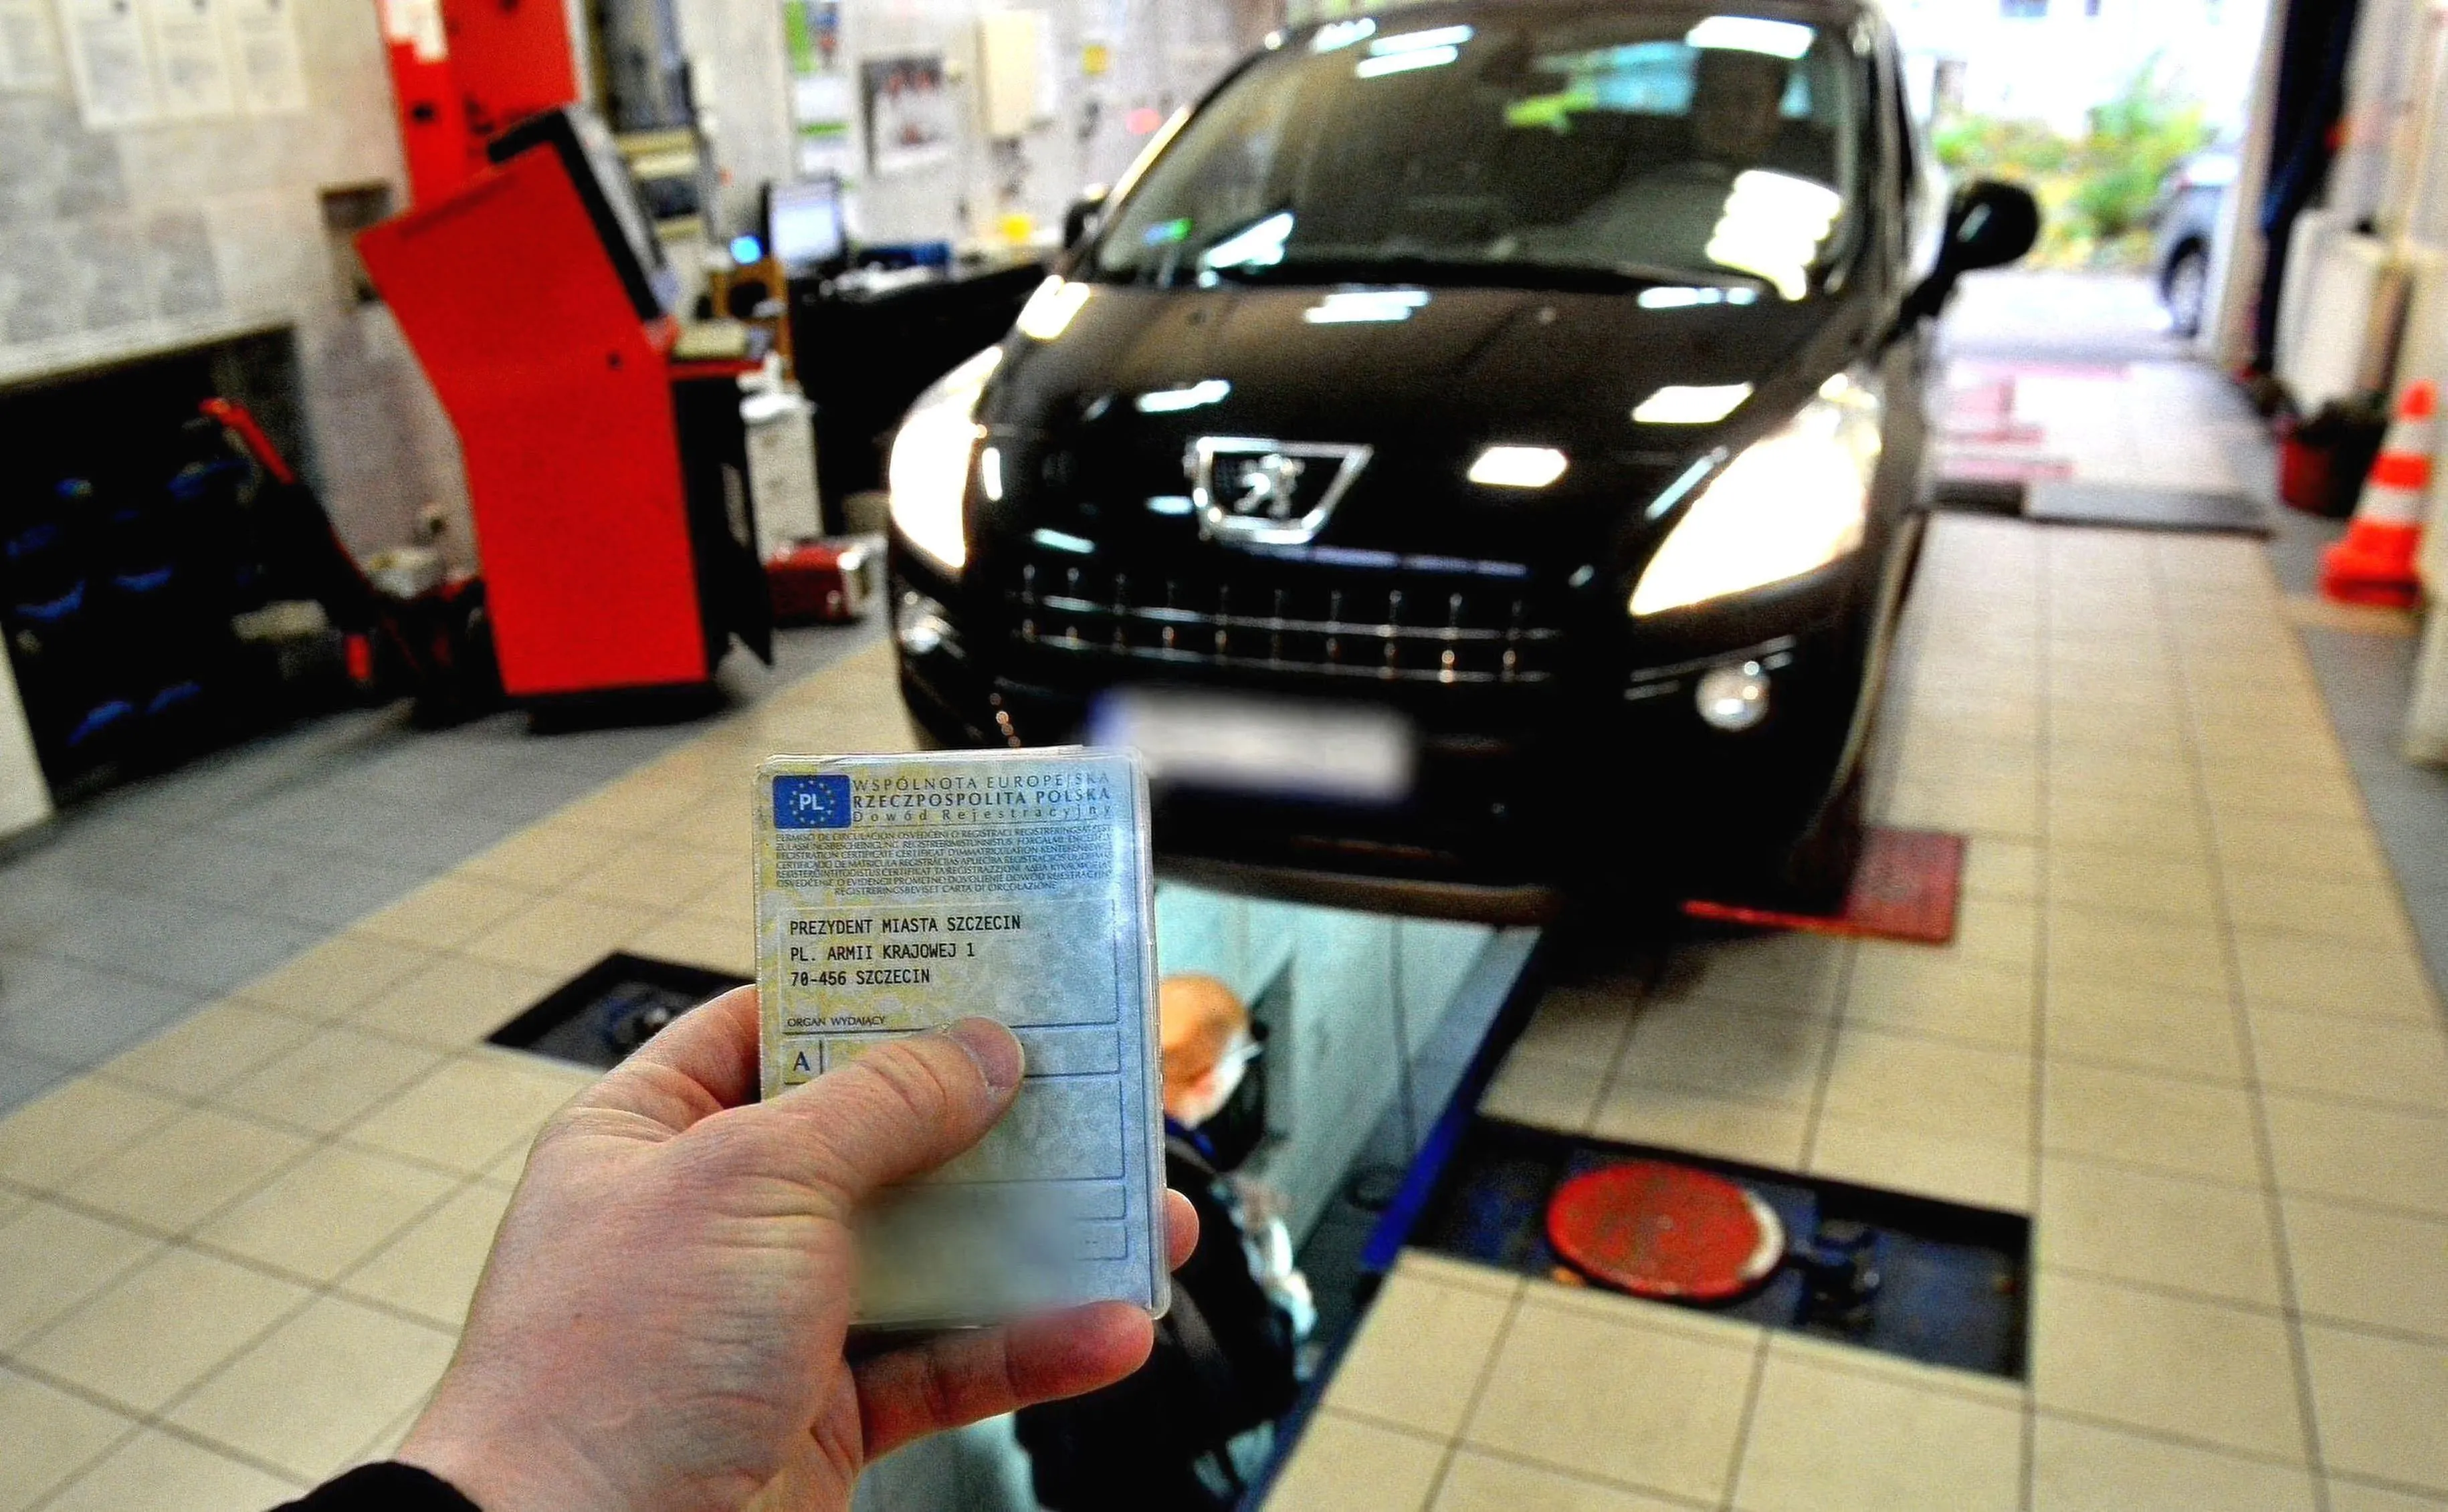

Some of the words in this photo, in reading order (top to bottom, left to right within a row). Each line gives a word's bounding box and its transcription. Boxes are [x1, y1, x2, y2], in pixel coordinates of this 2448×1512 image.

[853, 776, 977, 792] WSPÓLNOTA
[987, 773, 1109, 788] EUROPEJSKA
[800, 794, 824, 811] PL
[853, 792, 1026, 808] RZECZPOSPOLITA
[1037, 788, 1110, 803] POLSKA
[853, 810, 927, 822] Dowód
[942, 804, 1110, 822] Rejestracyjny
[791, 919, 873, 935] PREZYDENT
[882, 917, 938, 934] MIASTA
[948, 915, 1021, 932] SZCZECIN
[791, 947, 816, 961] PL.
[827, 946, 873, 960] ARMII
[883, 943, 956, 959] KRAJOWEJ
[967, 943, 975, 957] 1
[791, 971, 847, 986] 70-456
[856, 970, 930, 984] SZCZECIN
[787, 1018, 825, 1027] ORGAN
[793, 1051, 810, 1071] A
